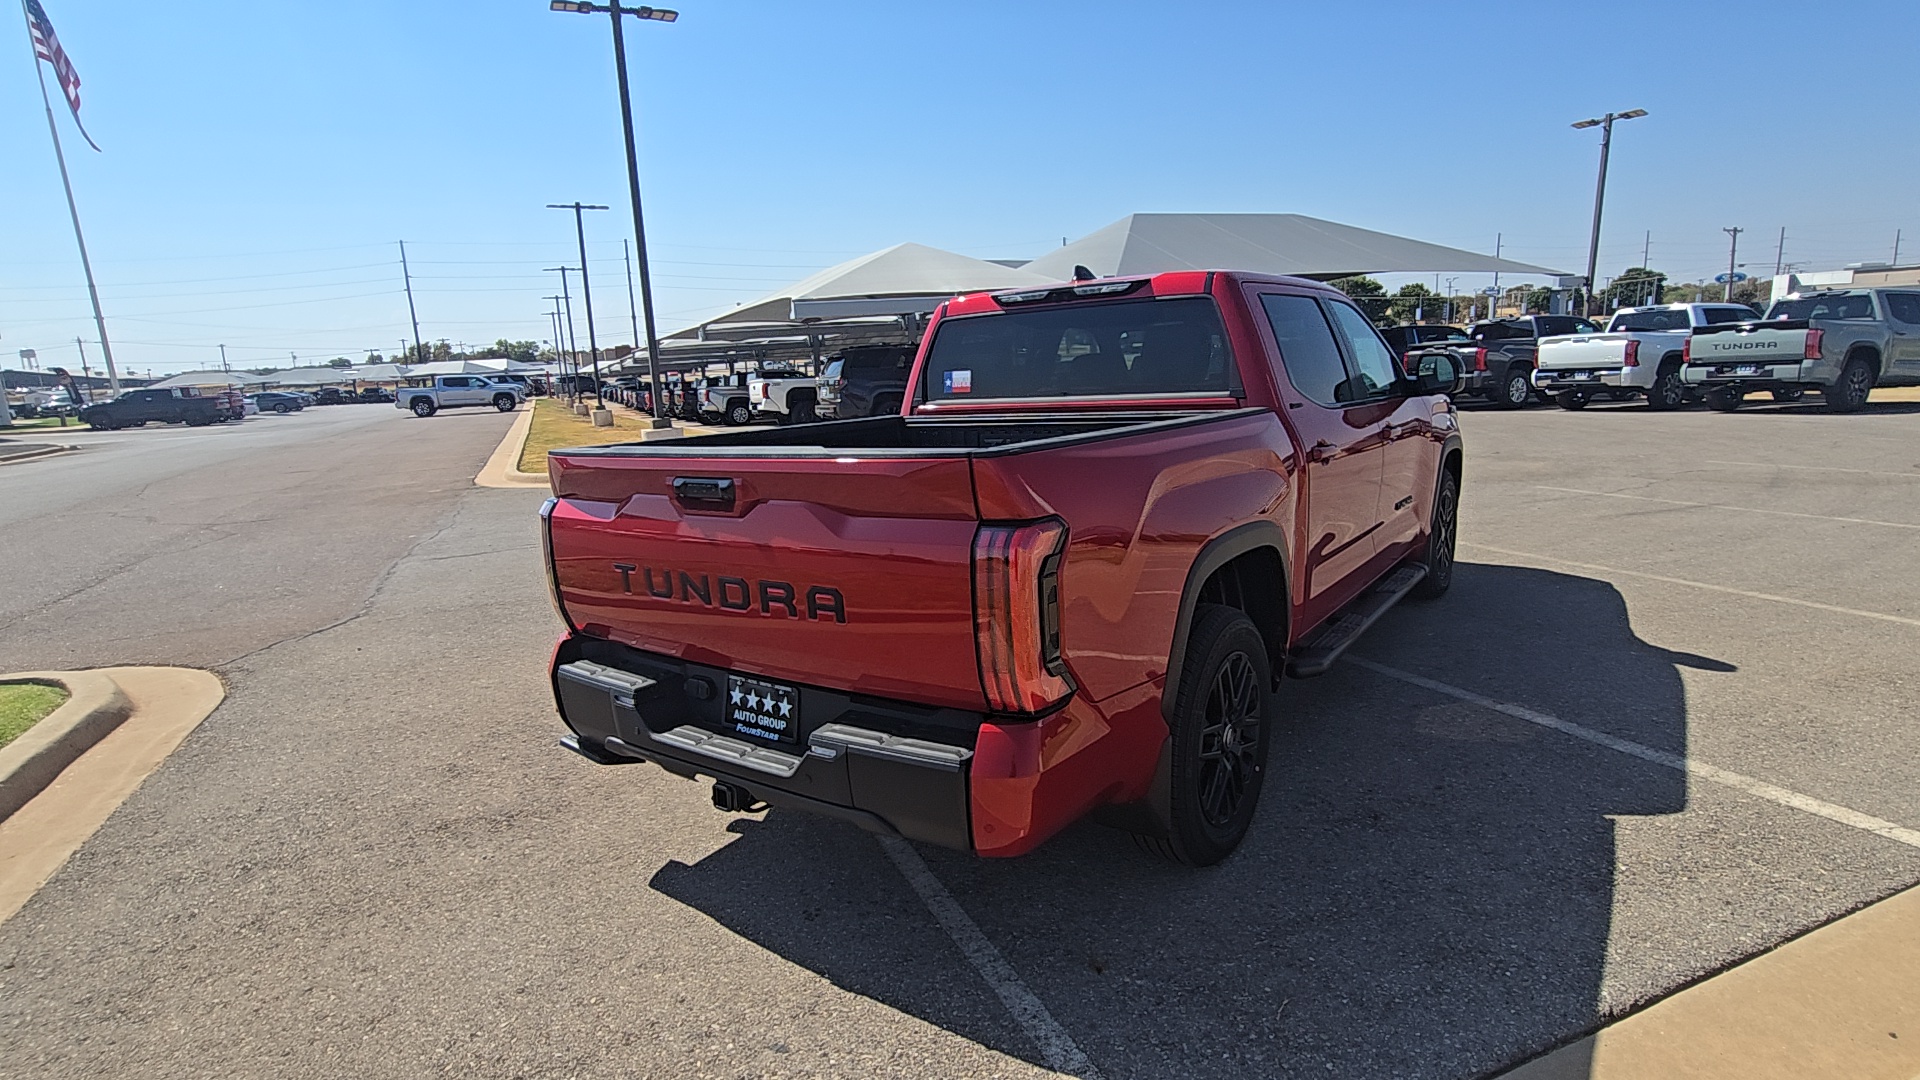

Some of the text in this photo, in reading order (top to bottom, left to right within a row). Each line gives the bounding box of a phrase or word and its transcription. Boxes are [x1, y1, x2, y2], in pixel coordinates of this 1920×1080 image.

[1711, 341, 1778, 351] TUNDRA
[613, 562, 848, 626] TUNDRA
[733, 708, 787, 731] AUTO GROUP
